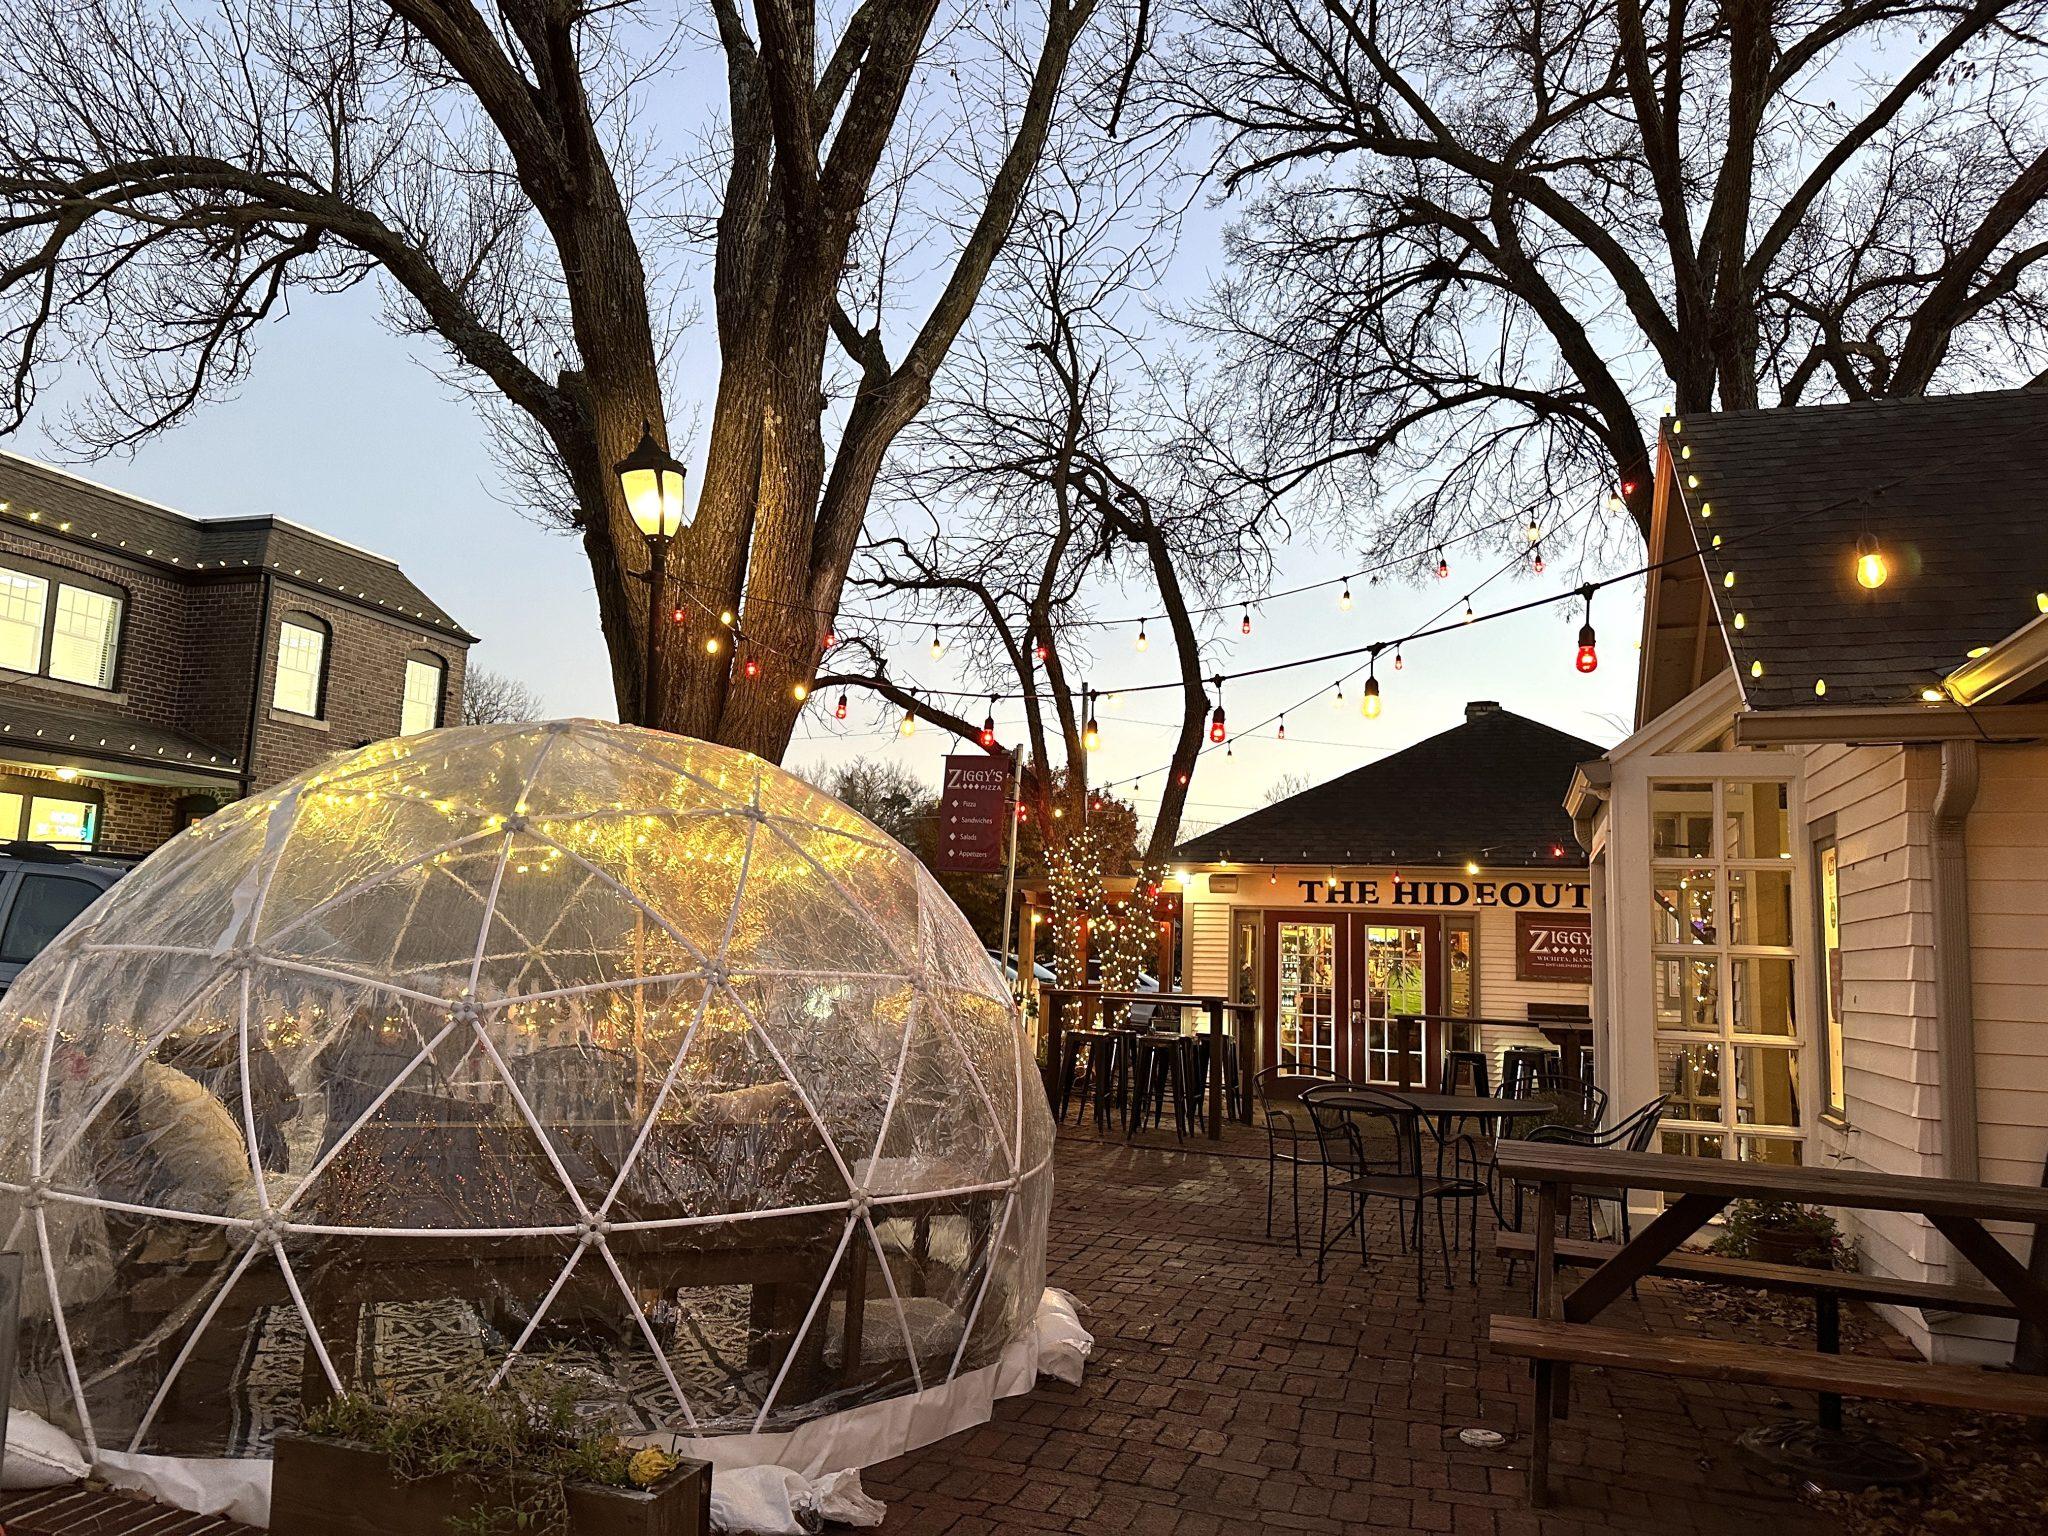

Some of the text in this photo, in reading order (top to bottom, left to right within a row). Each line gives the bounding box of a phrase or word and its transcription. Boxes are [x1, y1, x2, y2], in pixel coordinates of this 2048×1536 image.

[947, 769, 1003, 789] ZIGGY'S
[959, 850, 987, 858] Appetizers
[1298, 880, 1591, 909] THE HIDEOUT
